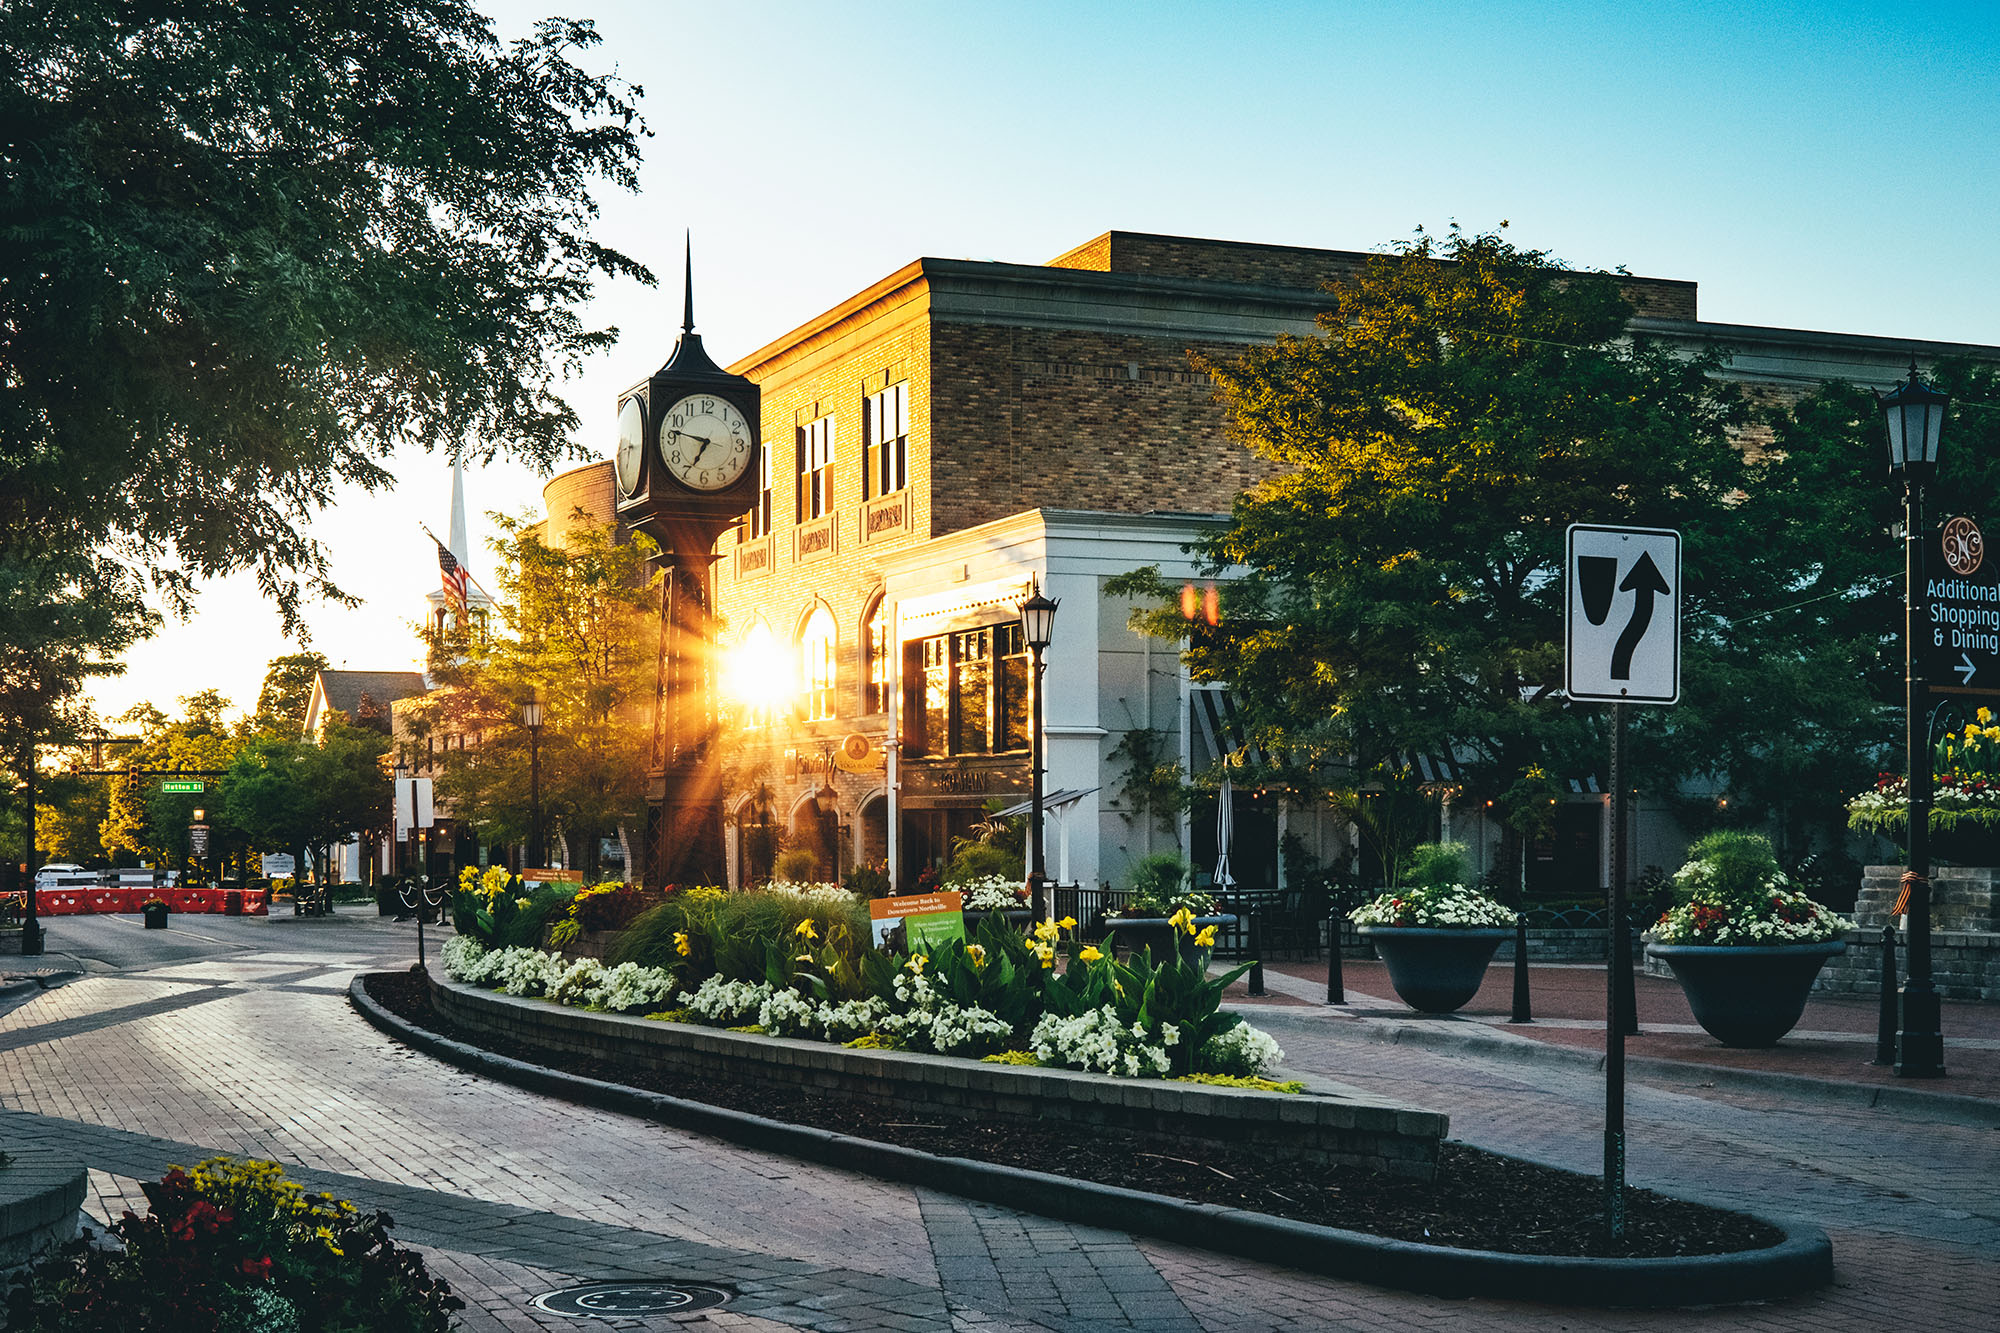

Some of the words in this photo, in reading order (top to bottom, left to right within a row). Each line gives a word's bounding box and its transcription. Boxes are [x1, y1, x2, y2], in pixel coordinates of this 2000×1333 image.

[685, 402, 694, 417] 11
[701, 400, 715, 414] 12
[672, 414, 684, 427] 10
[723, 408, 728, 421] 1
[732, 420, 741, 435] 2
[667, 430, 676, 445] 9
[735, 438, 744, 453] 3
[671, 450, 681, 464] 8
[728, 457, 737, 470] 4
[682, 465, 692, 479] 7
[700, 471, 709, 485] 6
[717, 468, 726, 481] 5
[1926, 579, 2000, 602] Additional
[1930, 603, 2000, 631] Shopping
[1933, 628, 1944, 647] &
[1952, 628, 1999, 656] Dining
[958, 771, 987, 792] MAIN
[887, 907, 918, 915] Downtown
[919, 903, 947, 912] Northville
